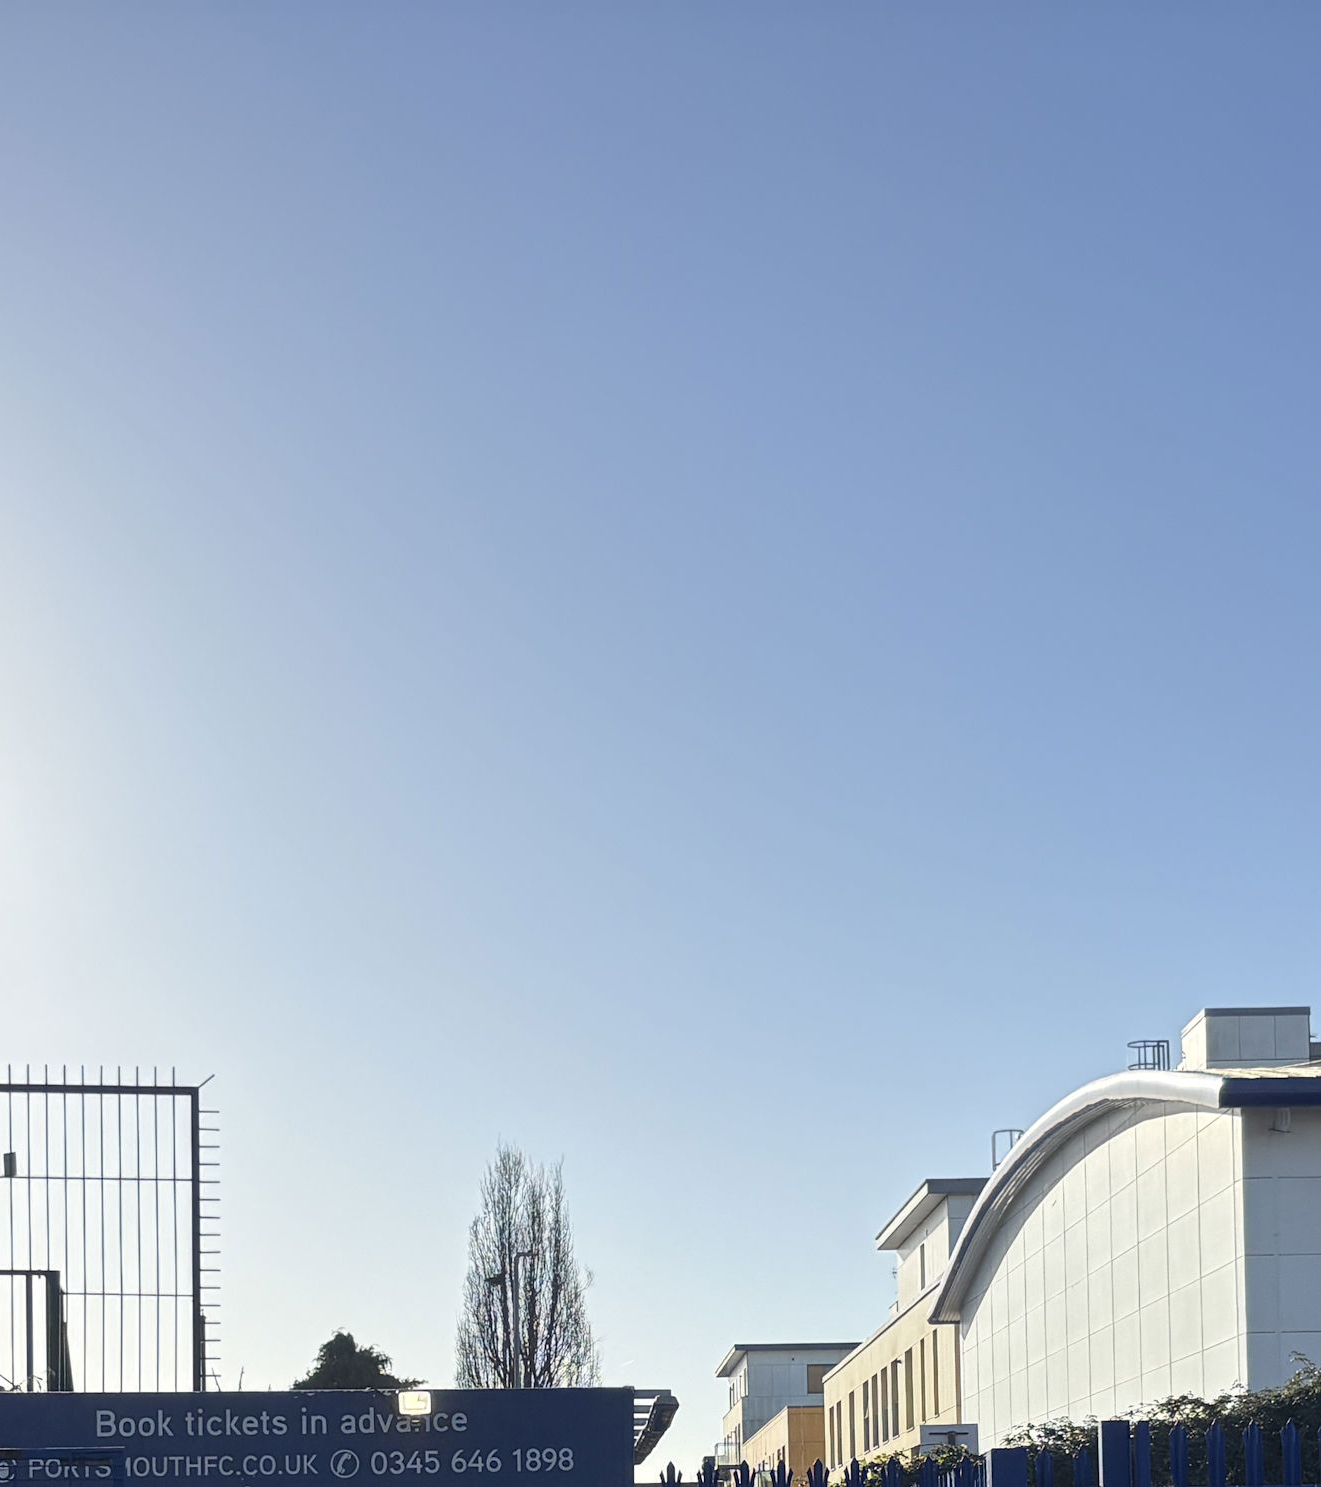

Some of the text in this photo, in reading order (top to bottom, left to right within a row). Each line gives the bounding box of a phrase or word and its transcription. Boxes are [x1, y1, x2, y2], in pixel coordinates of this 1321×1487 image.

[96, 1409, 173, 1438] Book
[185, 1408, 288, 1437] tickets
[301, 1407, 327, 1435] in
[28, 1447, 574, 1479] PORSOUTHFC.CO.UK 0345 646 1898
